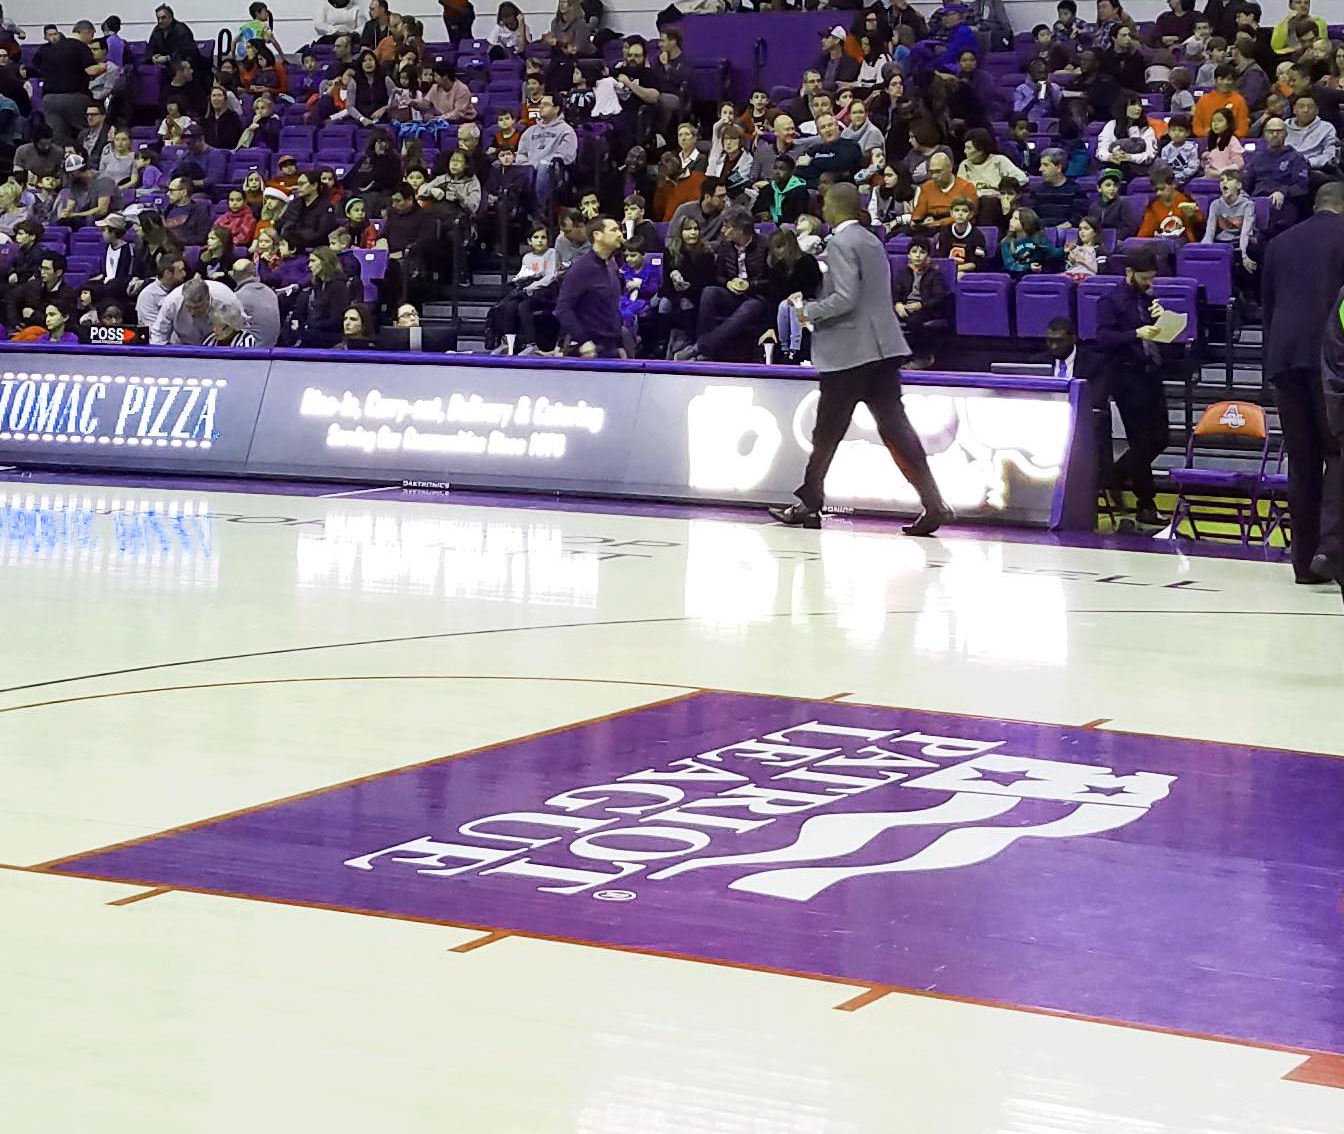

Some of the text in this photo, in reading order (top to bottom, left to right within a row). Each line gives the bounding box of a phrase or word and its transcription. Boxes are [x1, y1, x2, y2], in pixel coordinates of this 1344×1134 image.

[90, 327, 124, 340] POSS
[114, 384, 218, 439] PIZZA
[342, 719, 901, 877] LEAGUE
[480, 730, 1006, 896] PATRIOT
